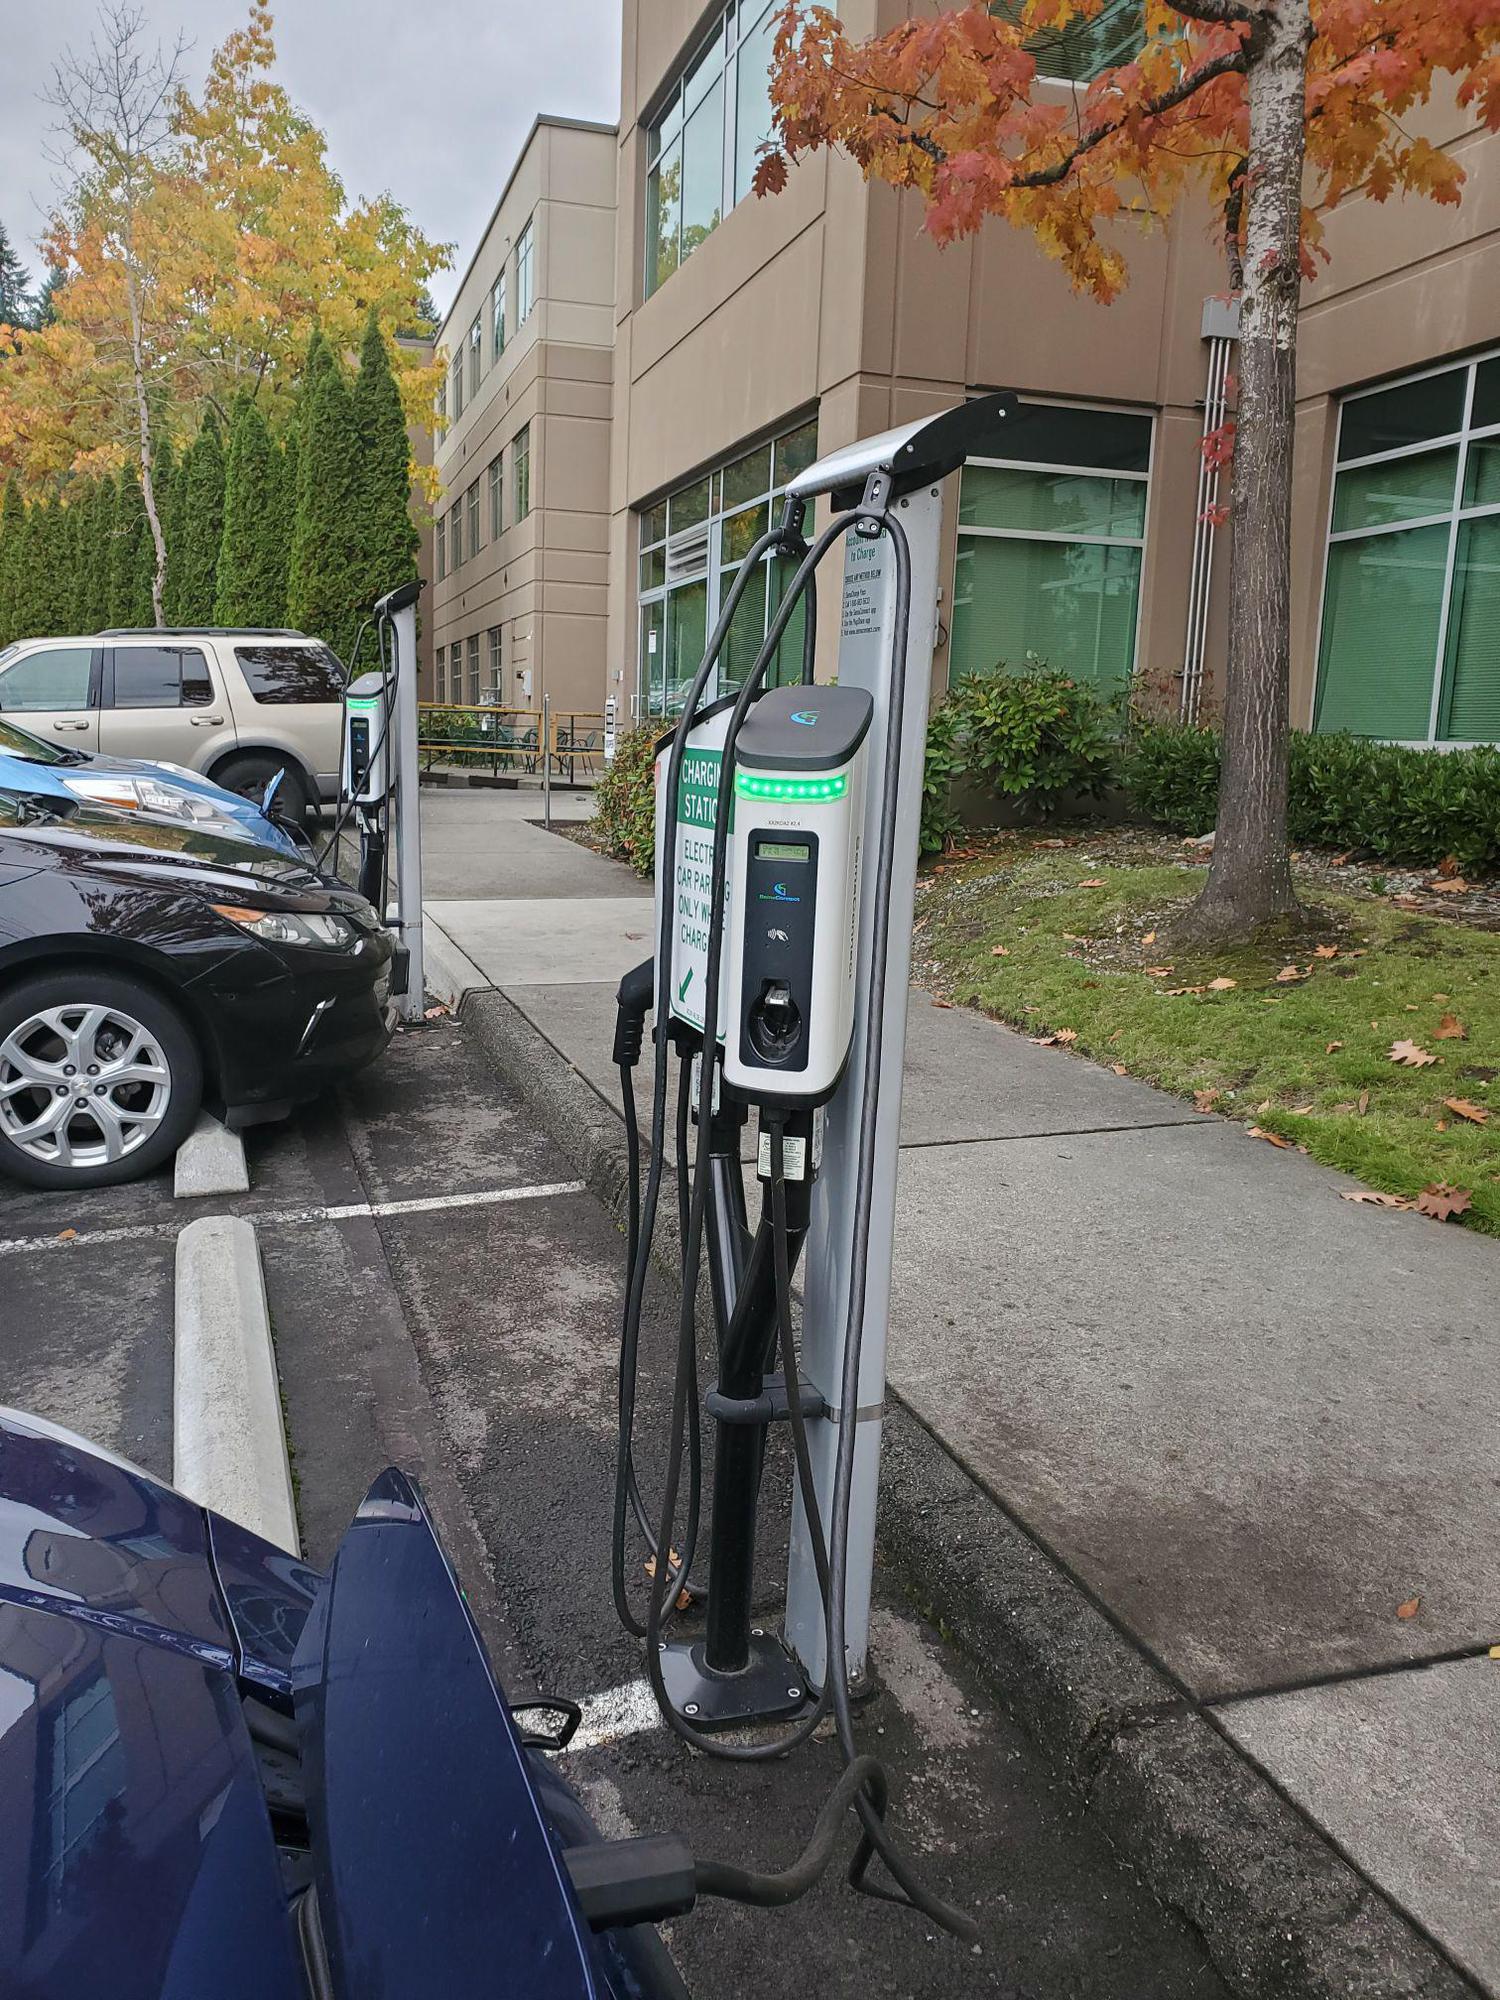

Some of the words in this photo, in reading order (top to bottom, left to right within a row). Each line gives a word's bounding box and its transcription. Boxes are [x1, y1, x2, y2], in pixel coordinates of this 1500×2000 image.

[857, 547, 876, 561] Charge
[684, 793, 718, 824] STATIO
[677, 865, 692, 889] CAR
[678, 894, 699, 920] ONLY
